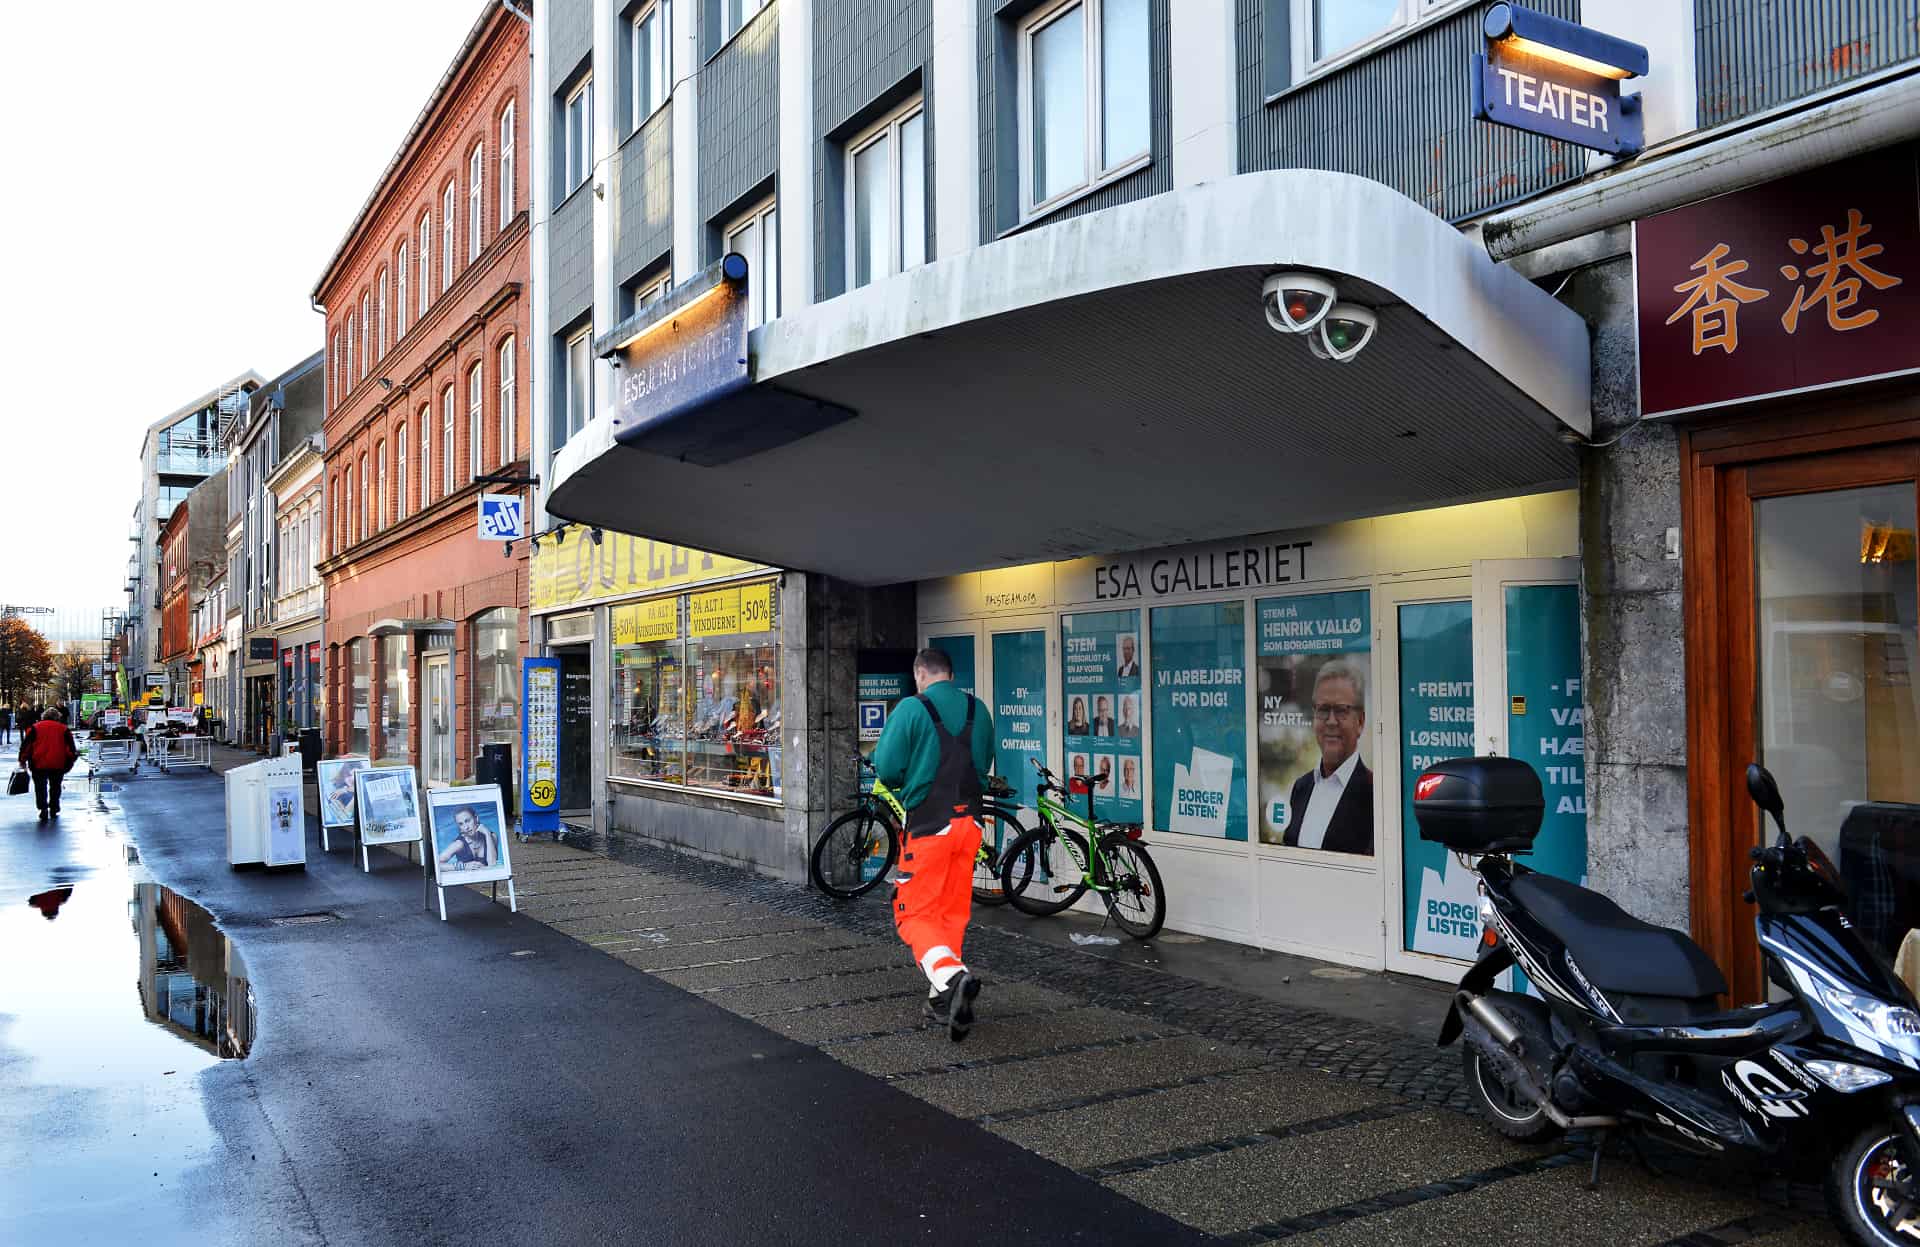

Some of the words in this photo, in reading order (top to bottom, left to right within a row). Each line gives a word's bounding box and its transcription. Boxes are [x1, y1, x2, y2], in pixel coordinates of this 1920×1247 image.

[1497, 68, 1609, 132] TEATER
[1665, 208, 1903, 355] 香港
[1095, 562, 1143, 600] ESA
[1150, 541, 1313, 595] GALLERIET
[741, 598, 769, 621] -50%
[1263, 608, 1286, 619] STEM
[637, 622, 674, 638] VINDUERNE
[693, 615, 737, 633] VINDUERNE
[1263, 622, 1314, 638] HENRIK
[1315, 617, 1362, 635] VALLØ
[1067, 637, 1097, 652] STEM
[1263, 641, 1282, 652] SOM
[1283, 639, 1343, 650] BORGMESTER
[1157, 671, 1171, 686] VI
[1173, 668, 1242, 686] ARBEJDER
[1418, 681, 1473, 697] FREMT
[1171, 692, 1197, 707] FOR
[1199, 691, 1228, 707] DIG!
[1264, 695, 1282, 709] NY
[865, 707, 880, 726] P
[999, 704, 1043, 717] UDVIKLING
[1429, 706, 1475, 722] SIKRE
[1012, 721, 1031, 733] MED
[1263, 712, 1312, 726] START...
[1001, 738, 1041, 750] OMTANKE
[1545, 766, 1584, 785] TIL
[1178, 789, 1224, 805] BORGER
[1272, 802, 1285, 824] E
[1427, 899, 1478, 922] BORG
